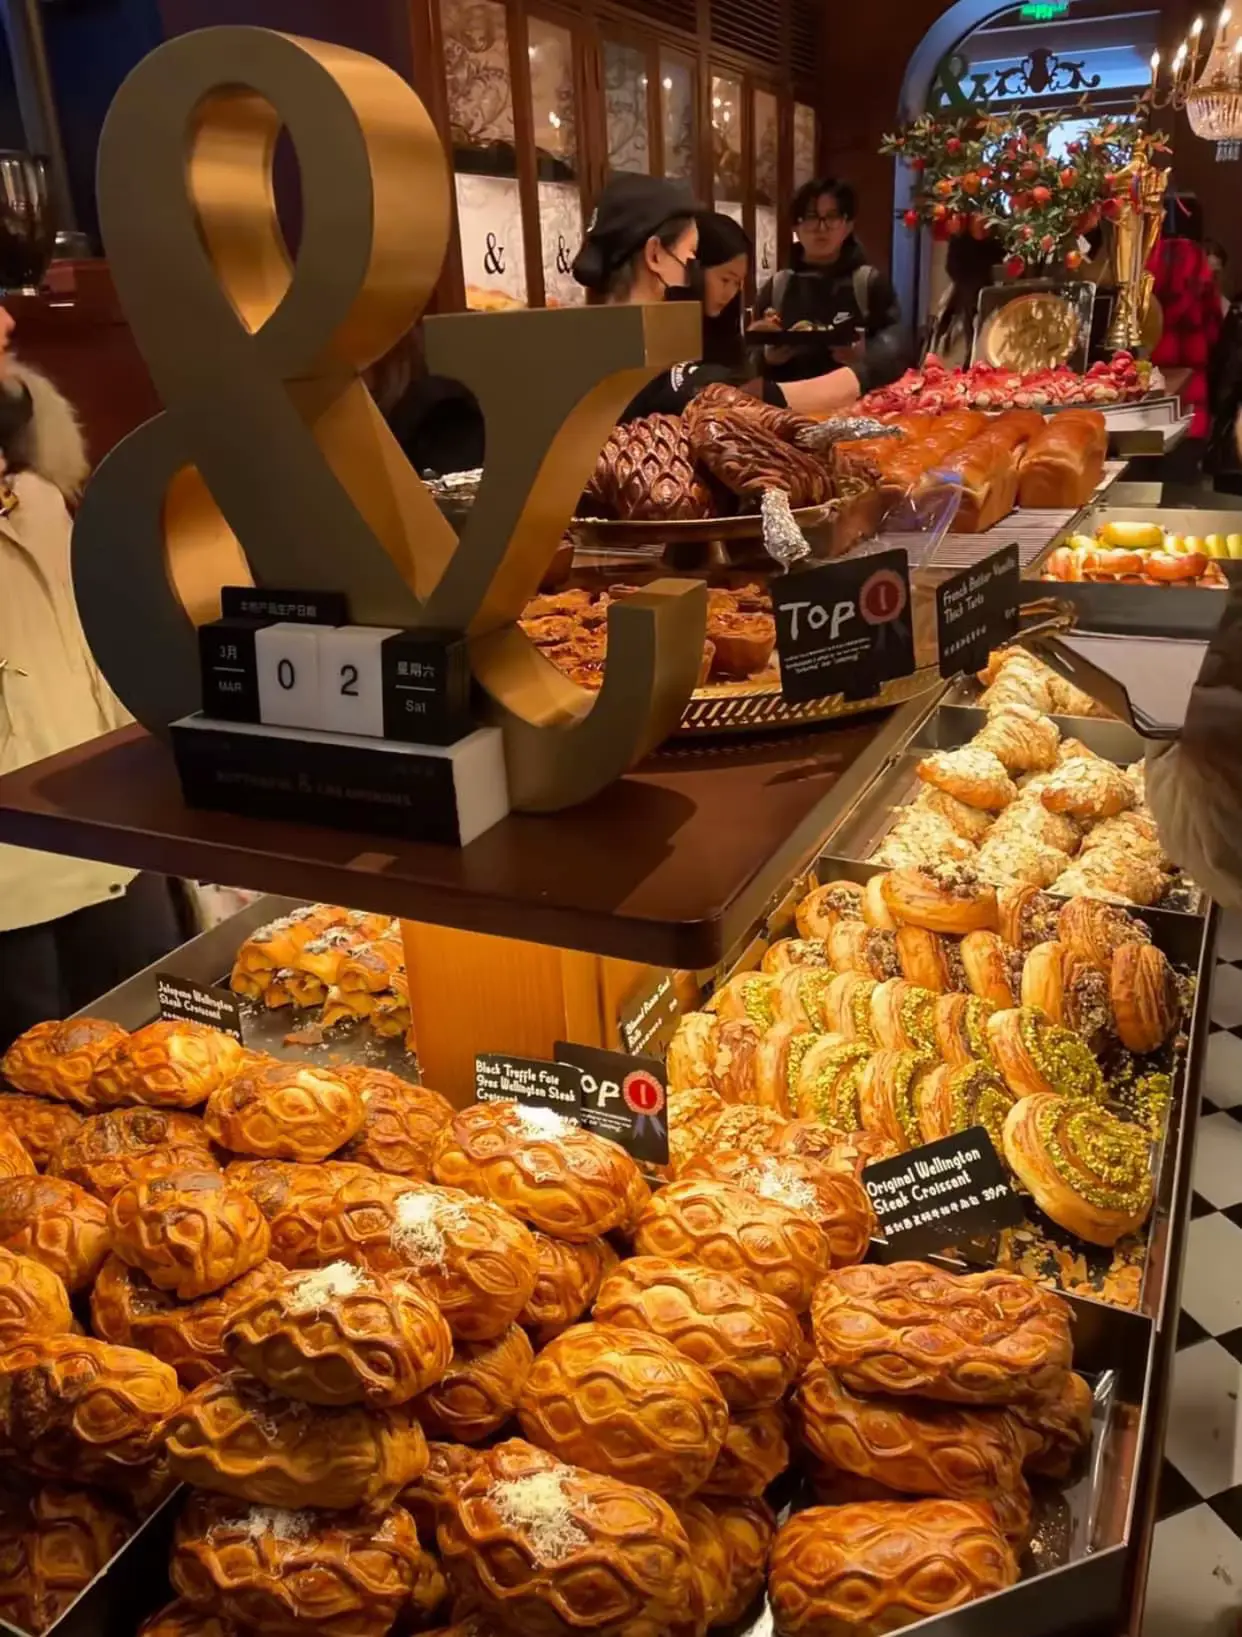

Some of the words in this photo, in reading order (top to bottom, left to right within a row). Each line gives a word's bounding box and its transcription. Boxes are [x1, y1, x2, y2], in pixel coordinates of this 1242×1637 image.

[484, 232, 505, 274] &
[556, 235, 573, 274] &
[71, 25, 703, 812] &
[397, 660, 436, 678] 星期六
[218, 680, 242, 692] MAR
[405, 699, 427, 714] Sat
[476, 1059, 501, 1074] Black
[503, 1063, 536, 1083] Truffle
[500, 1075, 546, 1097] Wellington
[548, 1086, 576, 1102] Steak
[866, 1168, 916, 1197] Original
[914, 1149, 981, 1180] Wellington
[873, 1191, 911, 1215] Steak
[911, 1170, 972, 1201] Croissant
